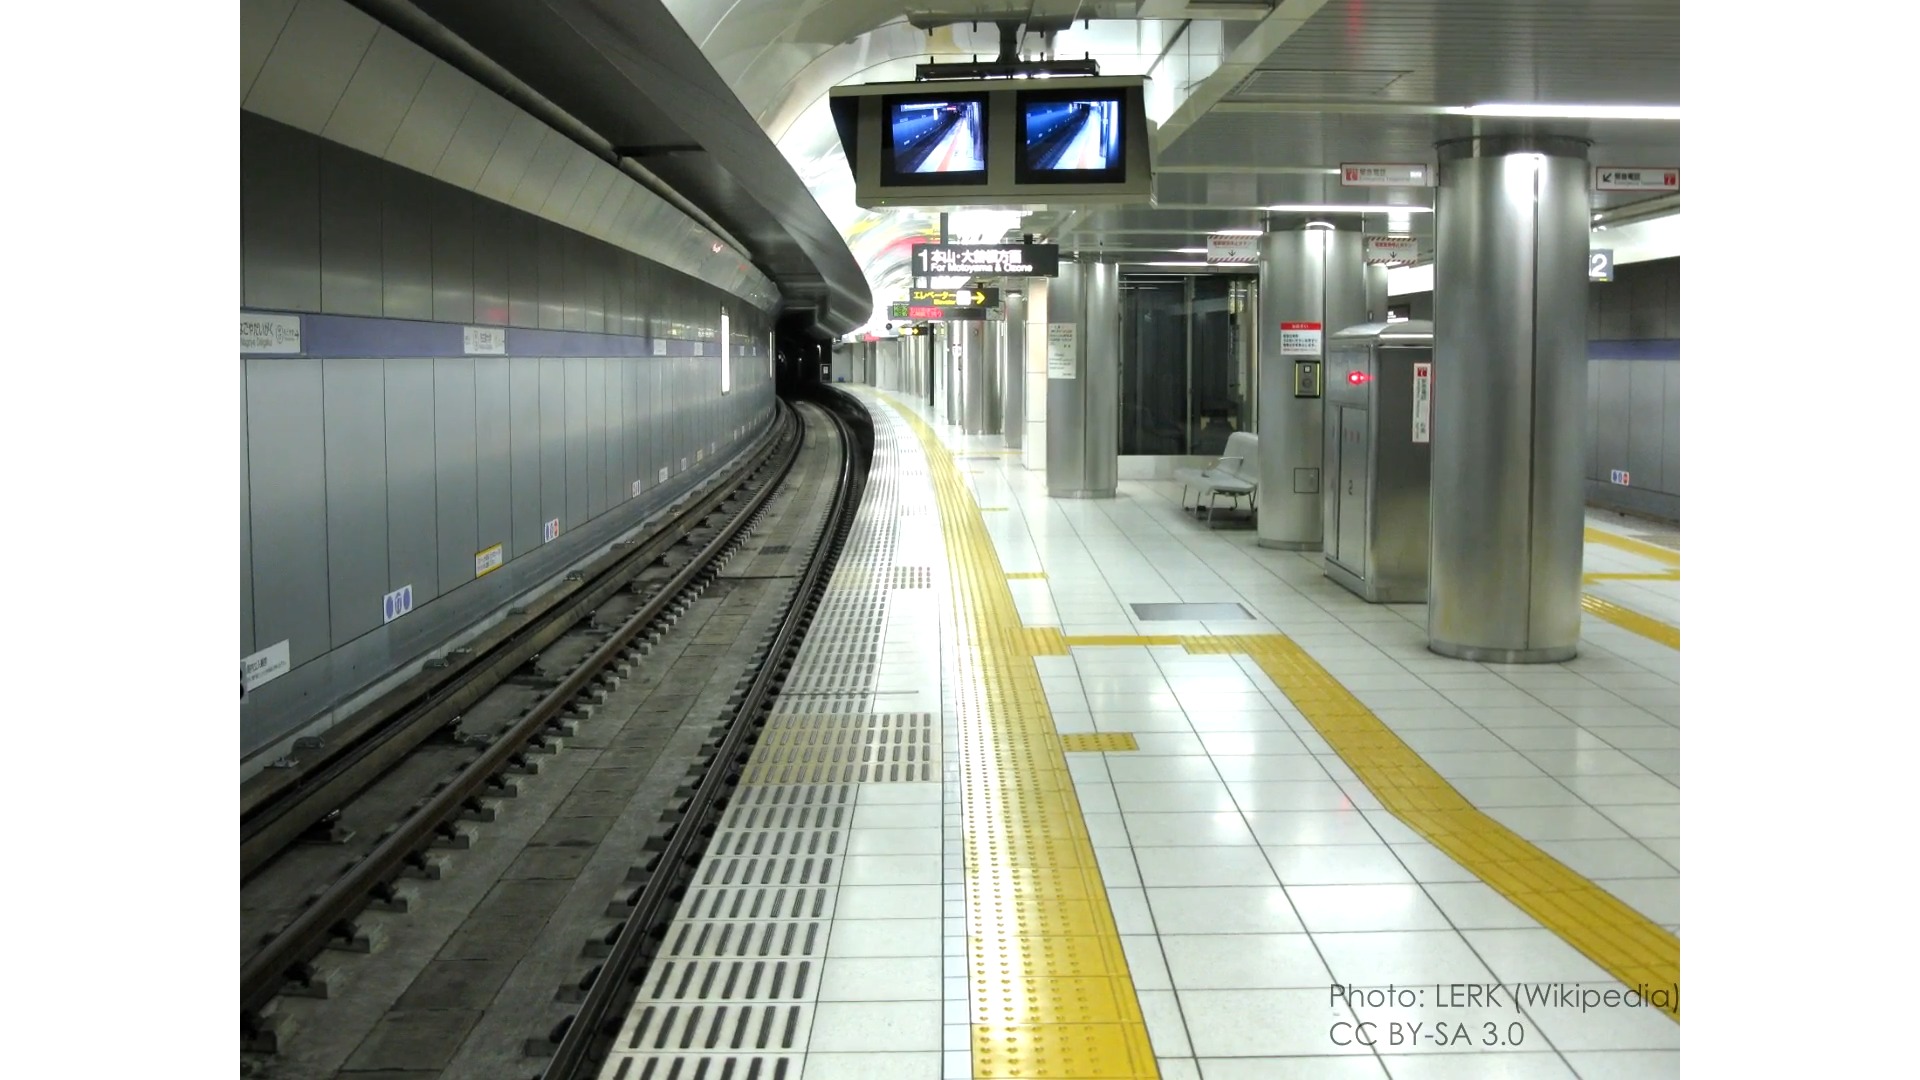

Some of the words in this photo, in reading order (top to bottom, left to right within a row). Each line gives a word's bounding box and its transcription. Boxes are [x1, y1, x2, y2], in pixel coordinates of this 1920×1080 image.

[918, 249, 928, 272] 1
[931, 263, 946, 272] For
[948, 263, 993, 274] Motoyama
[1592, 253, 1608, 278] 2
[913, 291, 956, 300] エレベーター
